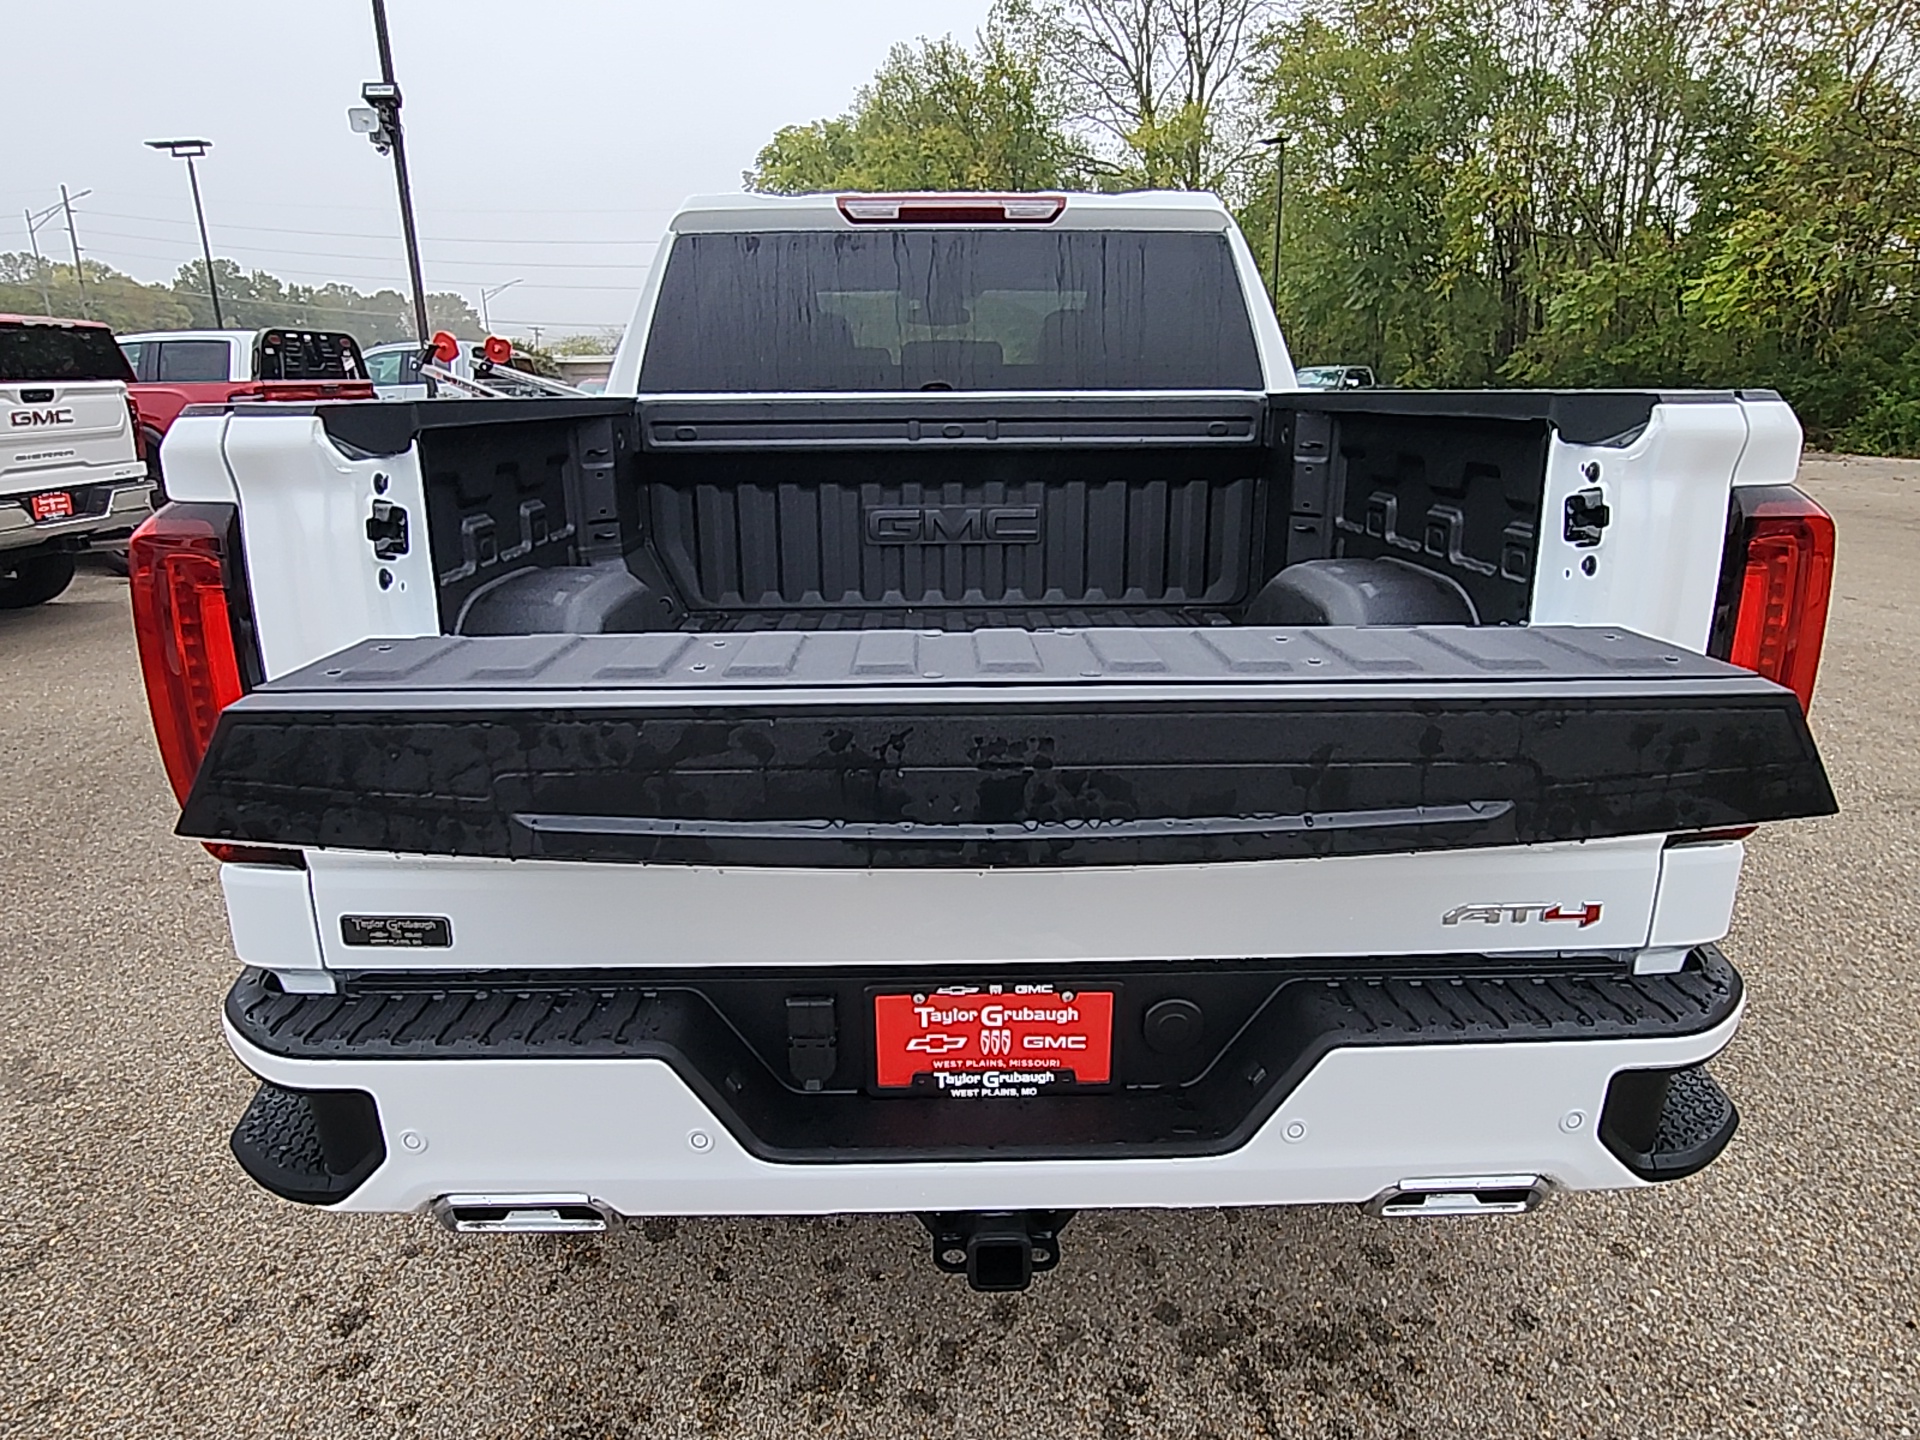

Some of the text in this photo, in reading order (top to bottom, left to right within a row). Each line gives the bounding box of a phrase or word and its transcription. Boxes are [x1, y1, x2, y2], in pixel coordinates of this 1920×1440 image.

[11, 409, 73, 427] GMC
[870, 509, 1038, 541] GMC
[1443, 901, 1602, 928] AT4
[1015, 984, 1053, 994] GMC
[914, 1005, 1079, 1028] Taylor Grubaugh
[1023, 1036, 1087, 1049] GMC
[933, 1059, 1060, 1068] WEST PLAINS, MISSOURI
[934, 1071, 1054, 1088] Taylor Grubaugh
[951, 1088, 1037, 1097] WEST PLAINS, MO
